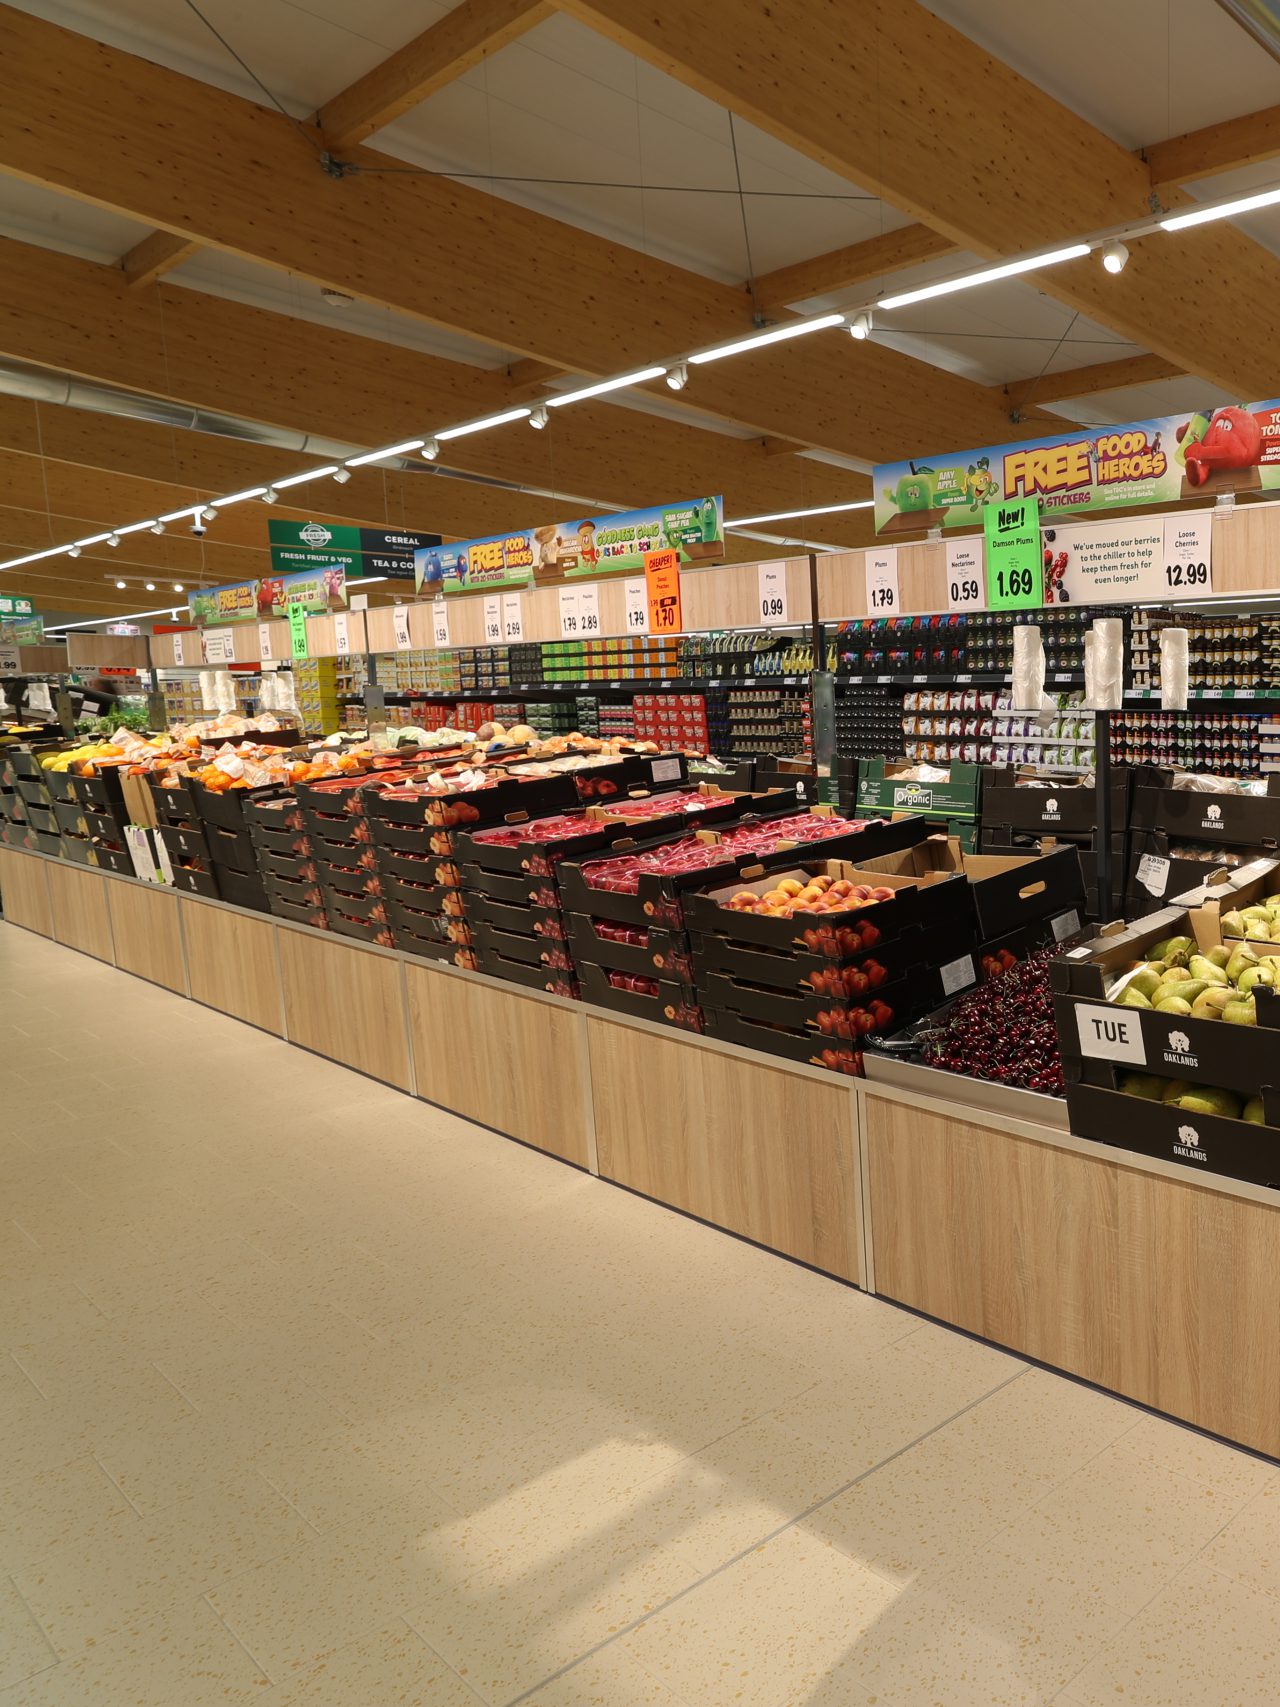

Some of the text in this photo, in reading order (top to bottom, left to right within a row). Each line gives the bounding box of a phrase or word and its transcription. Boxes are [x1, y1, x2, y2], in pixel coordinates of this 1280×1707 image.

[1096, 431, 1148, 459] FOOD
[938, 471, 956, 481] AMY
[1004, 440, 1092, 498] FREE
[1097, 451, 1167, 485] HEROES
[937, 479, 957, 490] APPLE
[1046, 491, 1091, 508] STICKERS
[997, 507, 1025, 528] New!
[384, 535, 420, 545] CEREAL
[596, 526, 635, 546] GOODNESS
[637, 522, 660, 539] GANG
[504, 536, 526, 553] FOOD
[611, 544, 628, 556] BACK
[992, 537, 1034, 549] Damson Plums
[1073, 543, 1094, 551] We've
[1095, 539, 1119, 549] moved
[1134, 536, 1161, 546] berries
[1174, 539, 1199, 548] Cherries
[280, 552, 306, 560] FRESH
[307, 554, 329, 562] FRUIT
[468, 541, 505, 575] FREE
[506, 549, 534, 569] HEROES
[648, 554, 673, 569] CHEAPER!
[956, 552, 970, 560] Loose
[1080, 554, 1088, 562] to
[1090, 553, 1102, 561] the
[1103, 551, 1126, 560] chiller
[1137, 548, 1153, 558] help
[372, 559, 390, 568] TEA
[391, 560, 398, 568] &
[874, 561, 888, 569] Plums
[951, 560, 976, 568] Nectarines
[1082, 561, 1152, 575] keep them fresh for
[996, 568, 1033, 597] 1.69
[1113, 573, 1139, 585] longer!
[1166, 562, 1207, 587] 12.99
[871, 588, 894, 608] 1.79
[951, 580, 979, 602] 0.59
[762, 599, 783, 617] 0.99
[563, 616, 577, 632] 1.79
[581, 615, 598, 630] 2.89
[628, 610, 644, 627] 1.79
[655, 608, 674, 628] 1.70
[487, 623, 499, 638] 1.99
[506, 621, 520, 637] 2.69
[0, 662, 17, 670] .99
[896, 791, 930, 806] Organic
[1091, 1019, 1130, 1045] TUE
[1163, 1052, 1199, 1068] OAKLANDS
[1173, 1145, 1208, 1162] OAKLANDS
